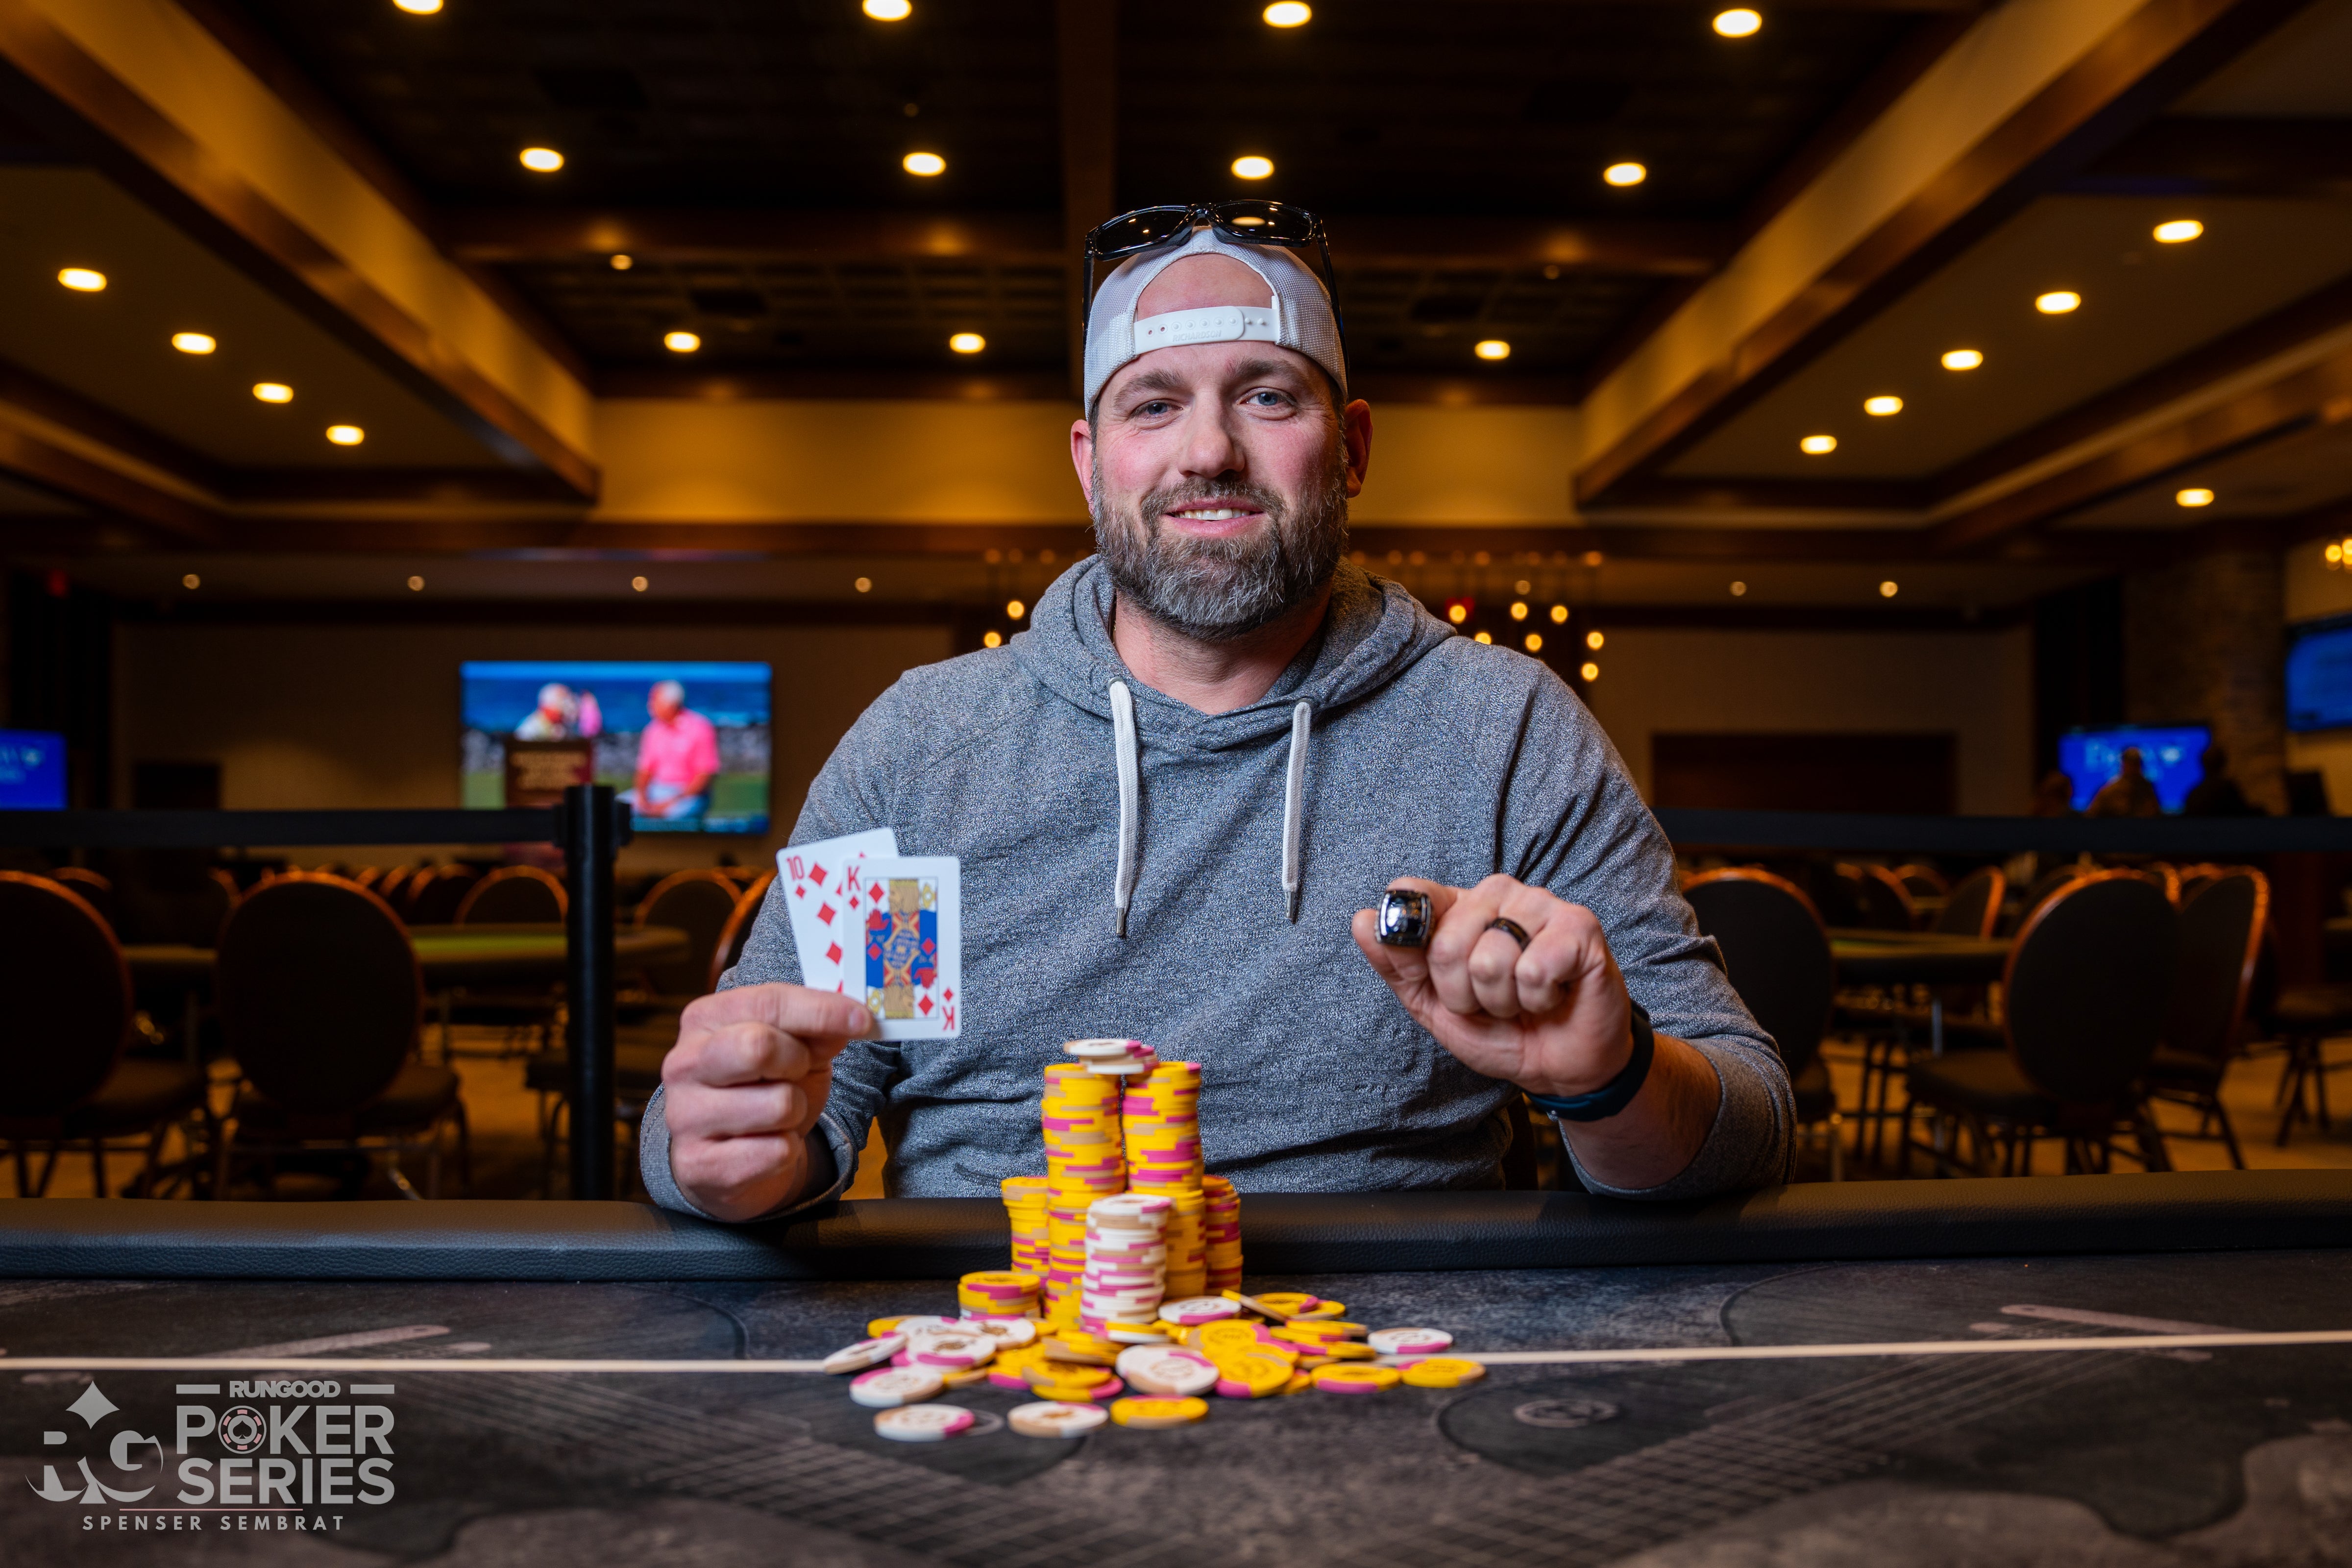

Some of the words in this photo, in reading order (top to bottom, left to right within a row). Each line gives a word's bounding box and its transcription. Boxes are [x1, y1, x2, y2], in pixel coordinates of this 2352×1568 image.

[1173, 330, 1222, 342] RICHARDSON
[786, 856, 805, 881] 10
[847, 865, 861, 891] K
[942, 1004, 955, 1031] K
